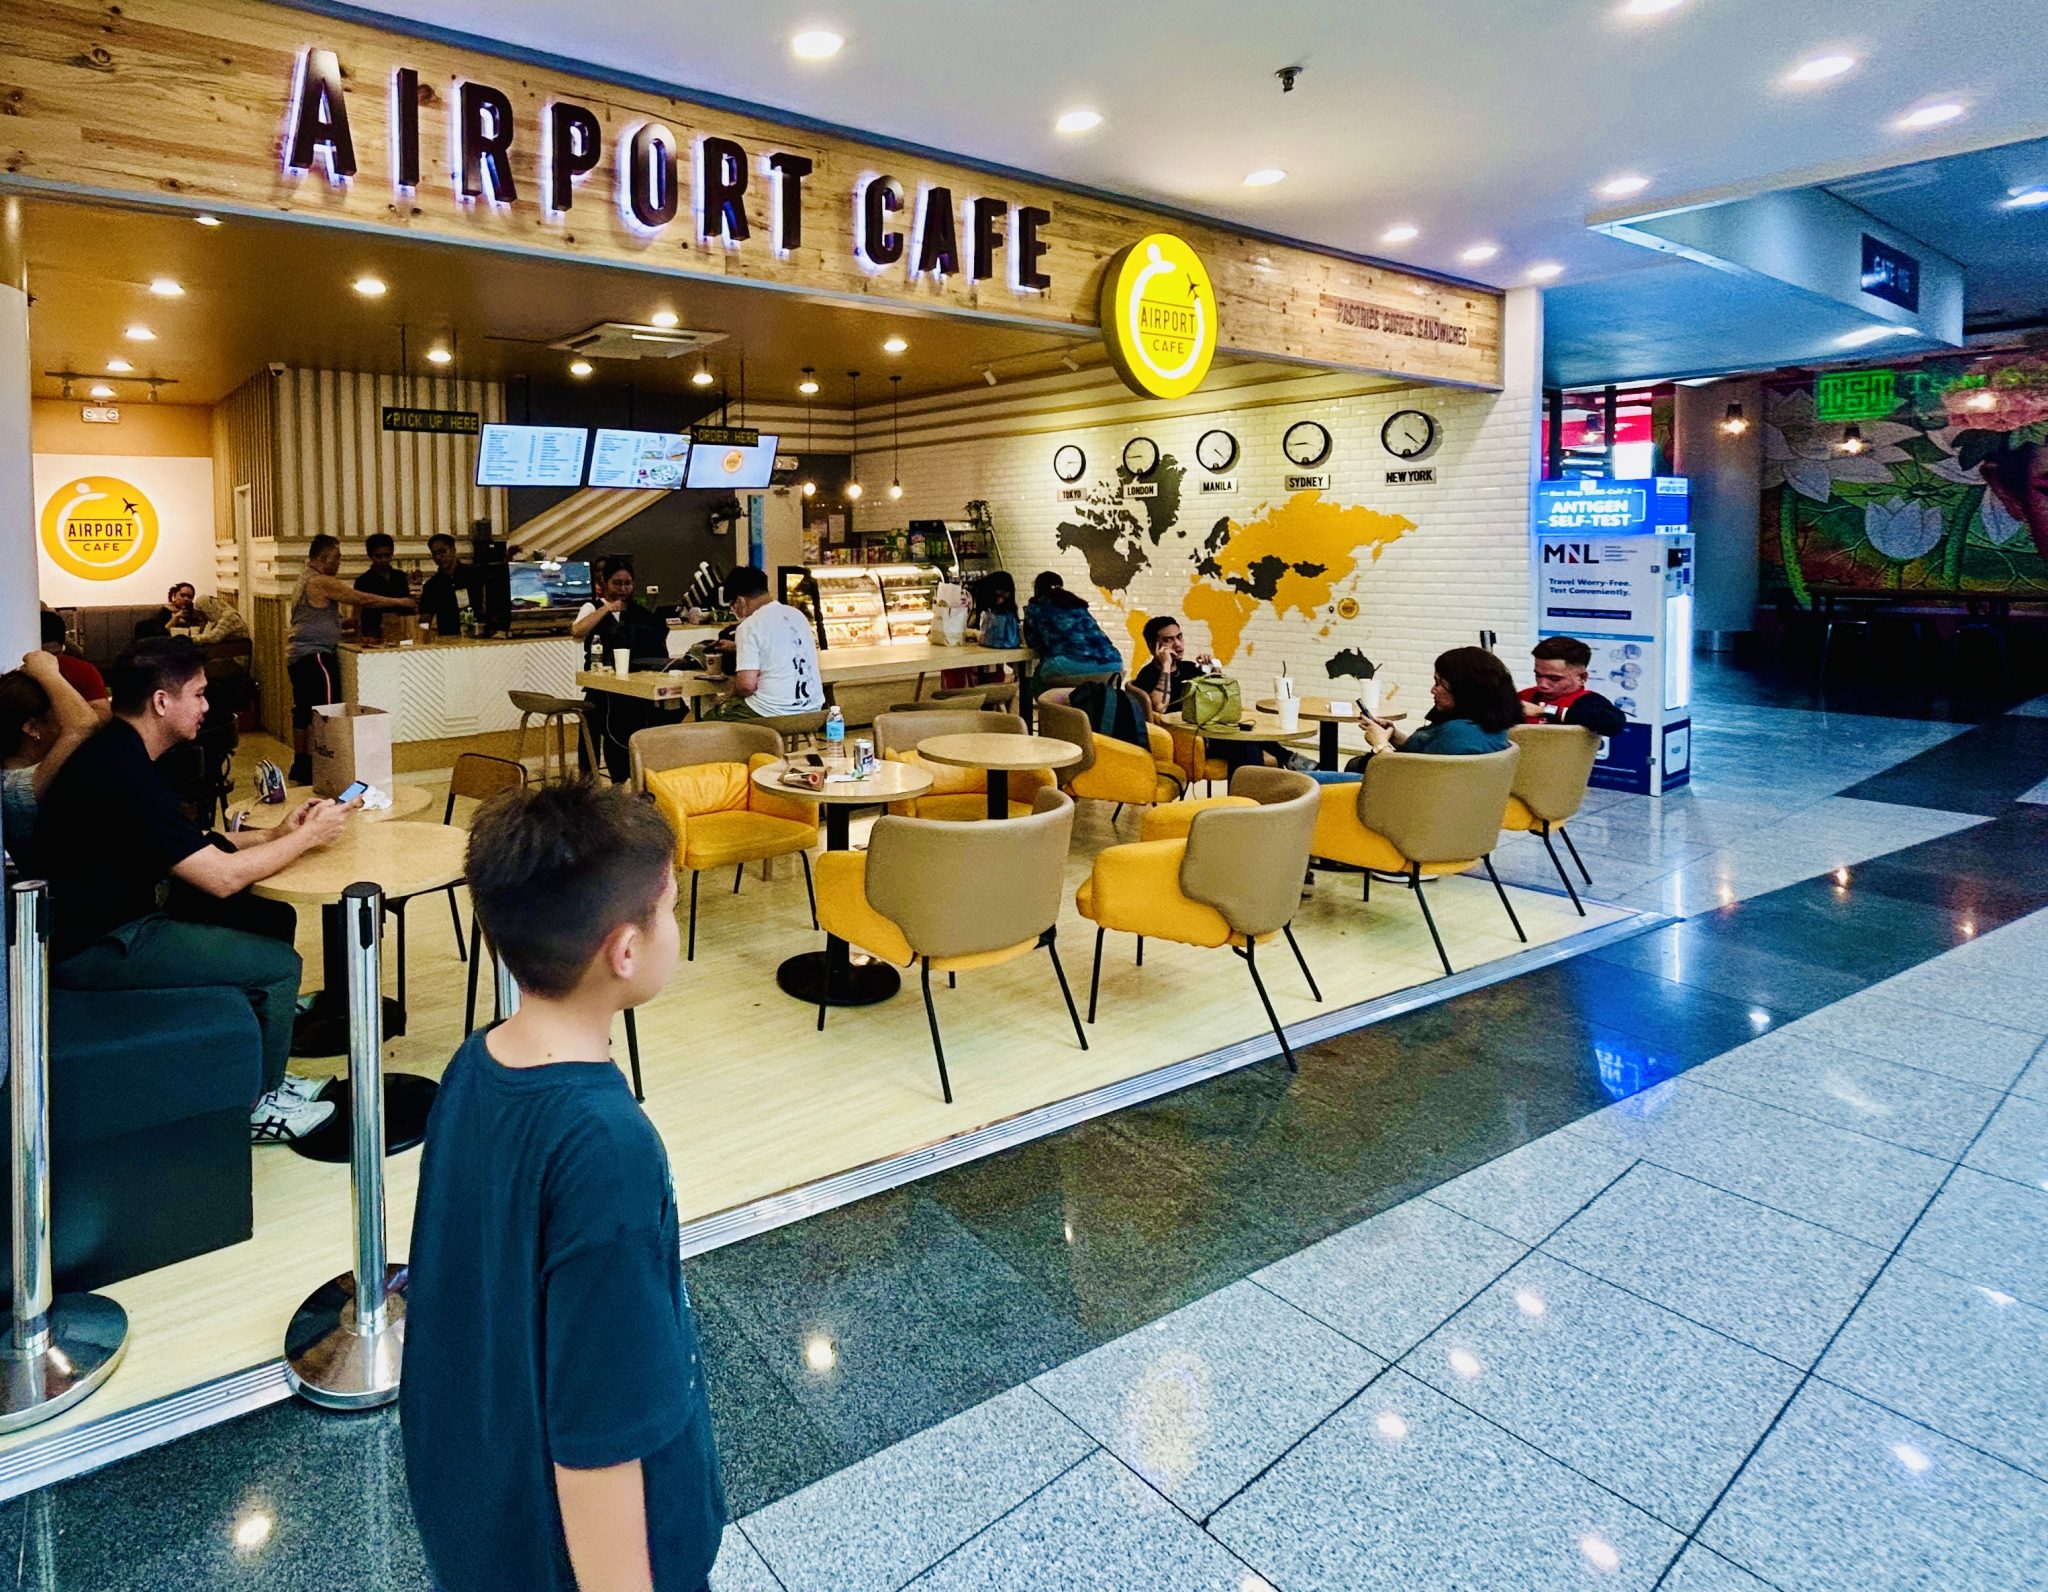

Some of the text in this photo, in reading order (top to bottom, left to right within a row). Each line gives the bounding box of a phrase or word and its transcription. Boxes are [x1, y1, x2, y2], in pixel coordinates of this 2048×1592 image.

[287, 47, 1051, 290] AIRPORT CAFE
[1140, 306, 1196, 335] AIRPORT
[1416, 318, 1467, 346] SANDWICHES
[1153, 339, 1185, 354] CAFE
[393, 412, 478, 430] PICK UP HERE
[698, 429, 758, 444] ORDER HERE
[1289, 476, 1323, 488] SYDNEY
[1386, 470, 1433, 483] NEW YORK
[1127, 484, 1154, 496] LONDON
[1202, 480, 1232, 492] MANILA
[1062, 489, 1082, 499] TOKYO
[1551, 499, 1629, 514] ANTIGEN
[1547, 513, 1632, 528] SELF-TEST
[68, 523, 133, 537] AIRPORT
[83, 543, 120, 552] CAFE
[1543, 544, 1600, 564] MNL
[1549, 578, 1632, 587] Travel Worry-Free.
[1568, 587, 1631, 597] Conveniently.
